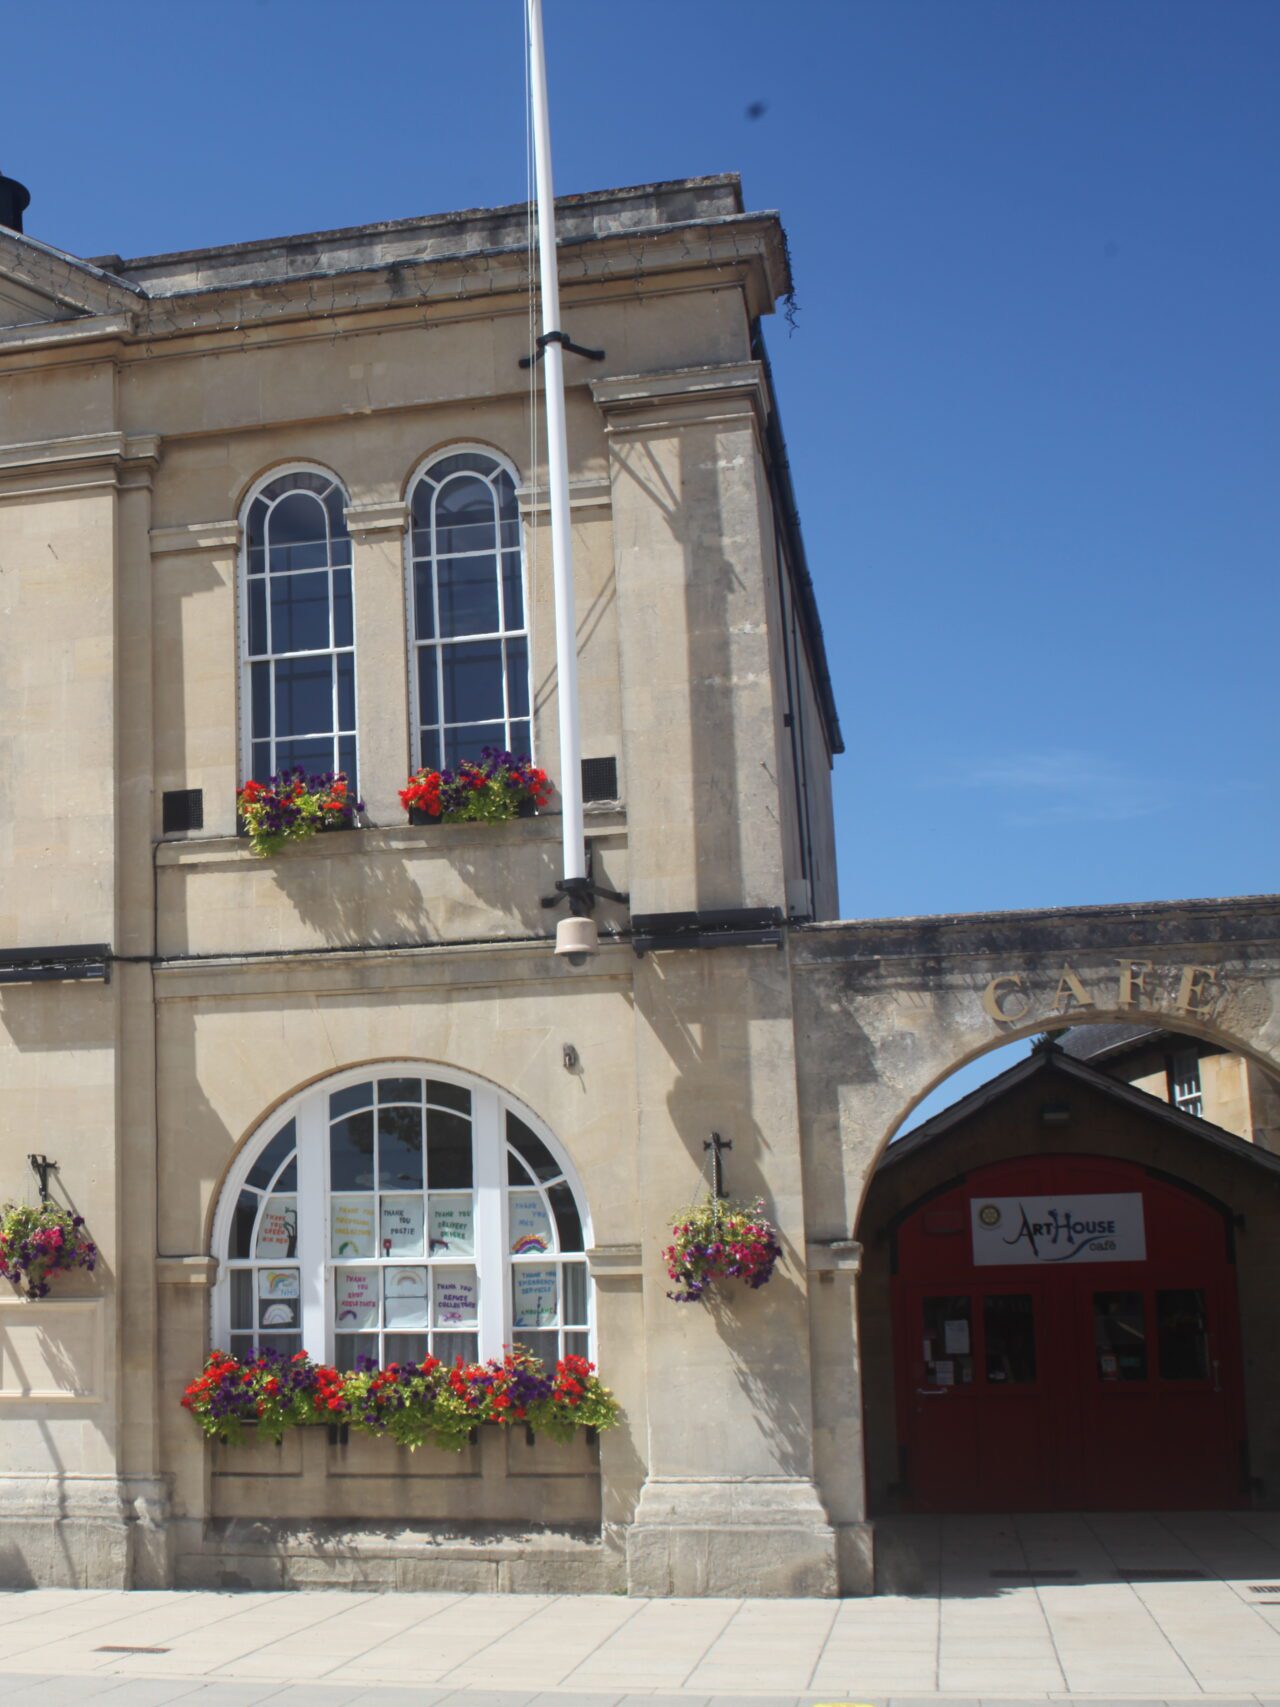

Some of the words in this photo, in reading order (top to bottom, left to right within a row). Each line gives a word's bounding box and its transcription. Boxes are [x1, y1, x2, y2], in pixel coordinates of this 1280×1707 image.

[983, 958, 1217, 1022] CAFE
[384, 1209, 404, 1217] THANK
[399, 1217, 411, 1225] YOU
[390, 1228, 415, 1236] POSTIE
[460, 1285, 473, 1293] YOU
